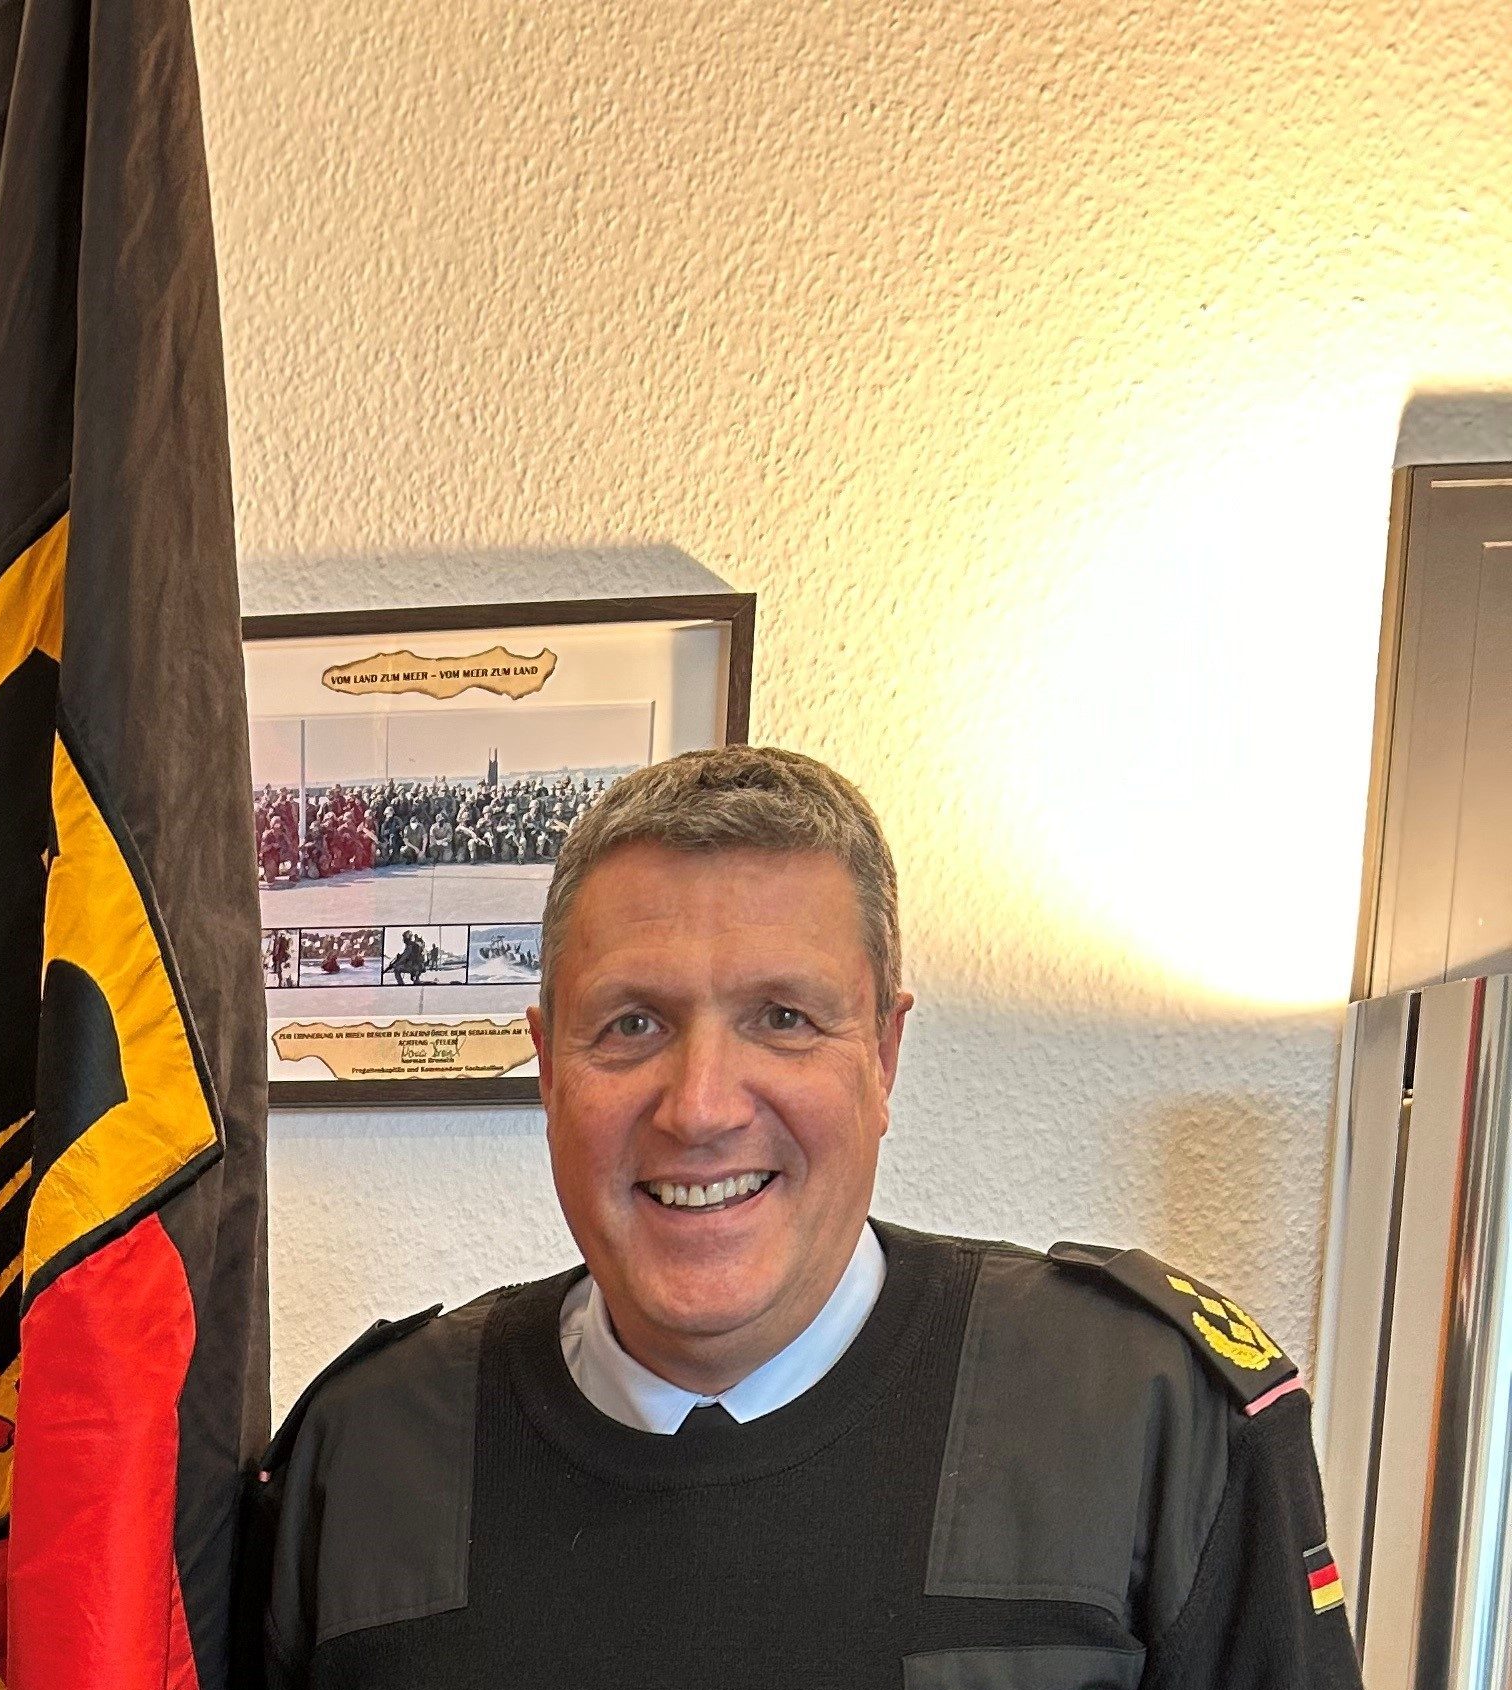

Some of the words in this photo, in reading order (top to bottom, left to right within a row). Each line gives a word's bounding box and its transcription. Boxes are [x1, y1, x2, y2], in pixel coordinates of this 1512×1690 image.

[331, 676, 351, 685] VOM
[353, 674, 378, 684] LAND
[380, 673, 400, 683] ZUM
[402, 672, 428, 681] MEER
[439, 670, 460, 679] VOM
[462, 668, 488, 678] MEER
[490, 667, 511, 677] ZUM
[513, 666, 538, 676] LAND
